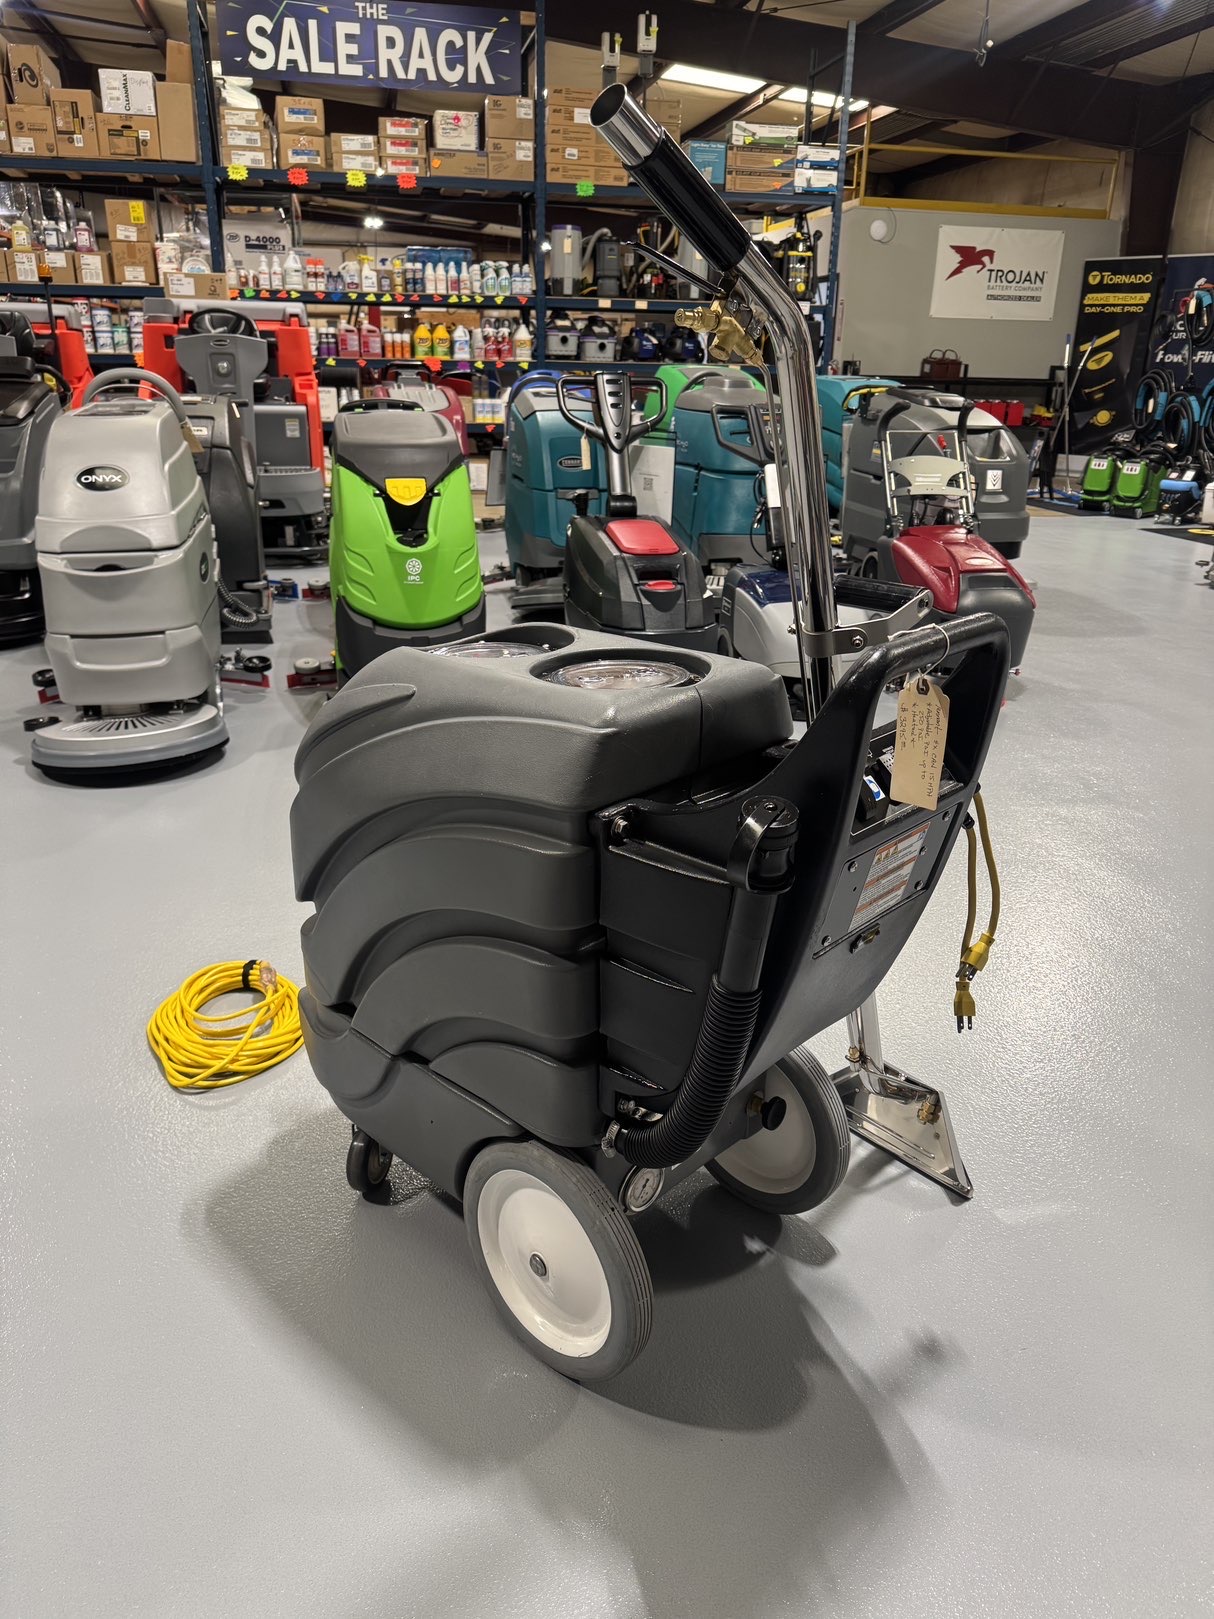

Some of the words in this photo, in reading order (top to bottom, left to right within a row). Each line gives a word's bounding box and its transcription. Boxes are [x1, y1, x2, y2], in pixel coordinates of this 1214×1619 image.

[355, 2, 389, 20] THE
[246, 14, 364, 77] SALE
[377, 24, 496, 85] RACK
[244, 235, 281, 244] D-4000
[987, 269, 1045, 285] TROJAN
[1102, 272, 1152, 284] TORNADO
[81, 474, 122, 483] ONYX
